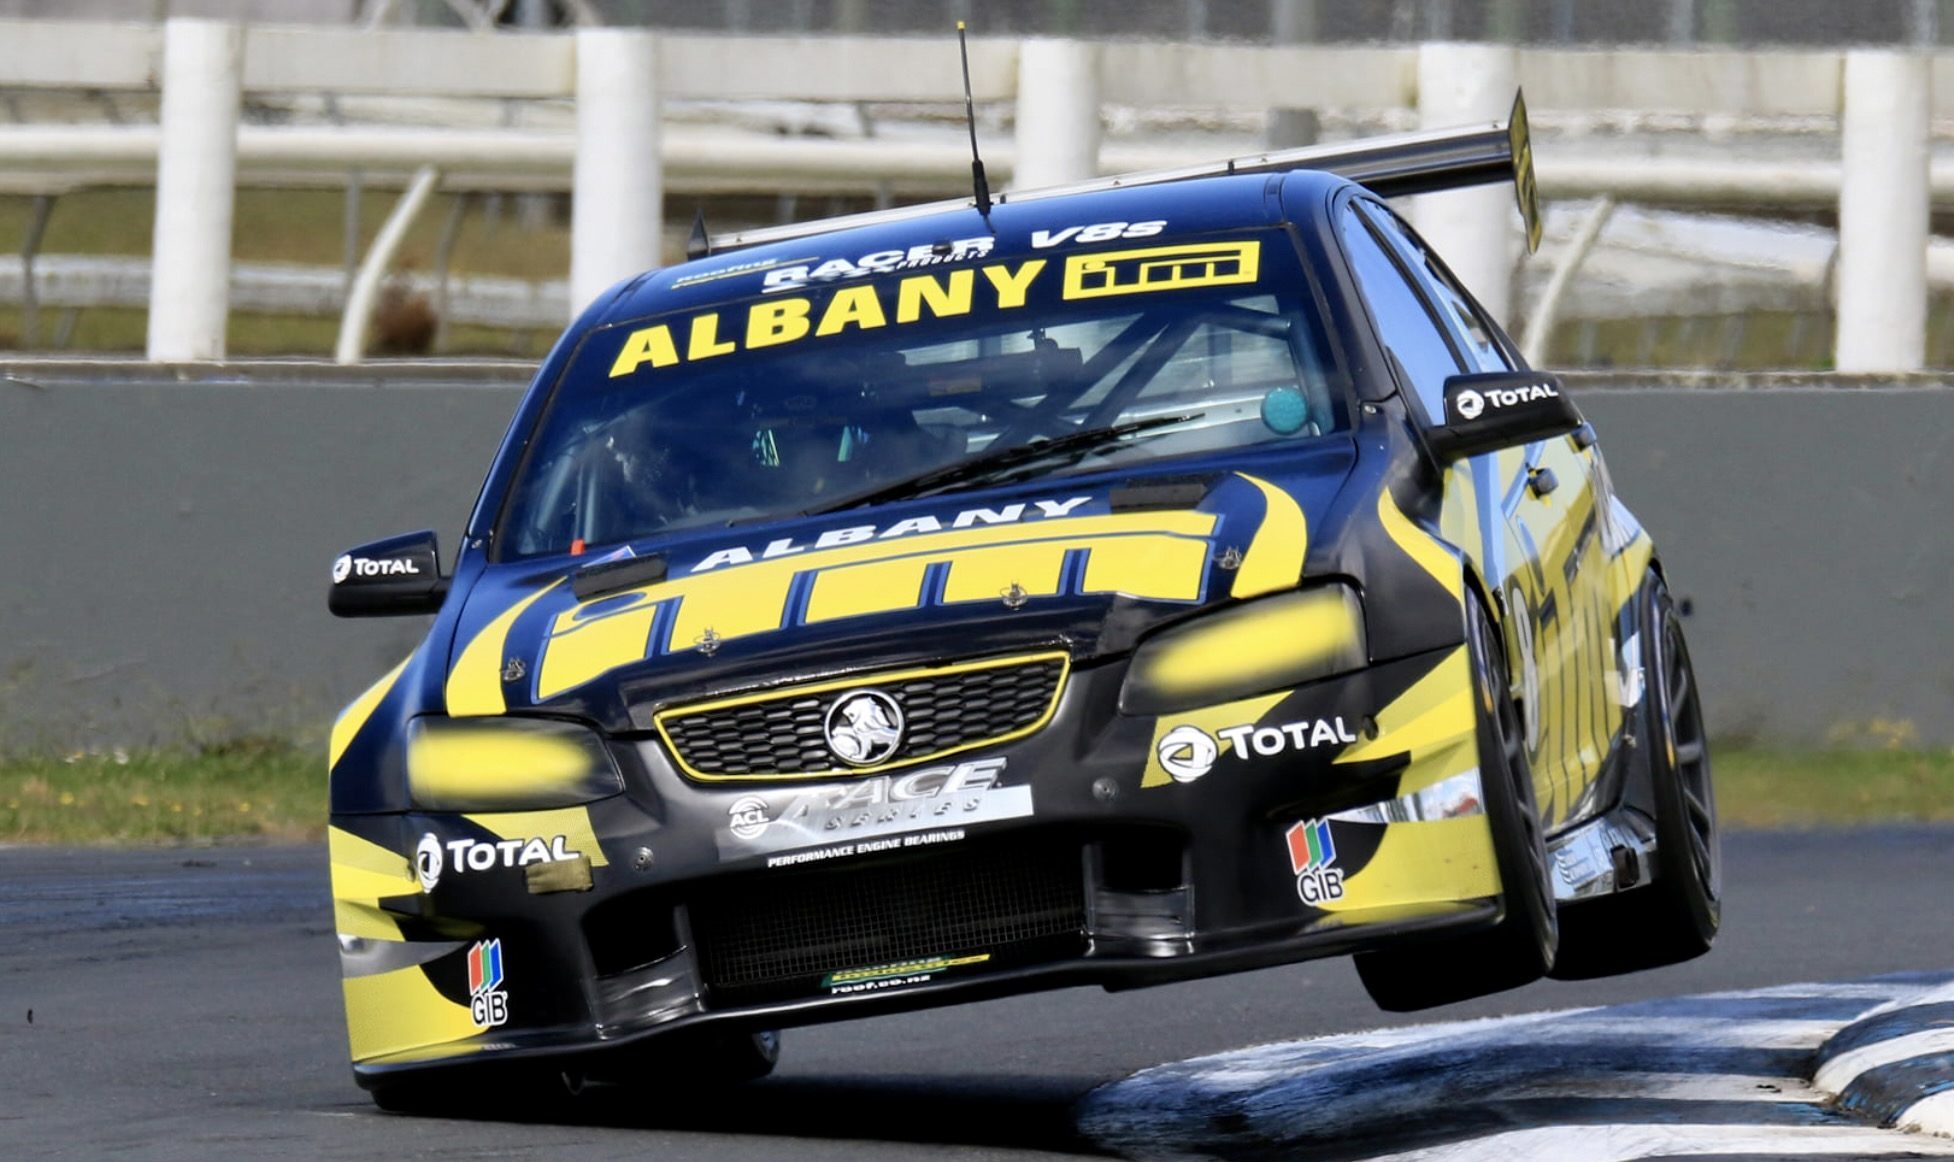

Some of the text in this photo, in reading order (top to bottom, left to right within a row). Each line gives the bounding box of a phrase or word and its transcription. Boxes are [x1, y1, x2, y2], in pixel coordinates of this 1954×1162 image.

[1031, 220, 1168, 249] V8s
[609, 260, 1048, 378] ALBANY
[1485, 384, 1559, 408] TOTAL
[691, 497, 1093, 572] ALBANY
[354, 558, 420, 576] TOTAL
[1219, 716, 1358, 761] TOTAL
[729, 809, 770, 829] ACL
[446, 836, 581, 874] TOTAL
[767, 829, 966, 868] PERFORMANCE ENGINE BEARINGS
[1298, 869, 1346, 906] GIB
[831, 974, 931, 995] roof.co.nz
[471, 991, 509, 1027] GIB
